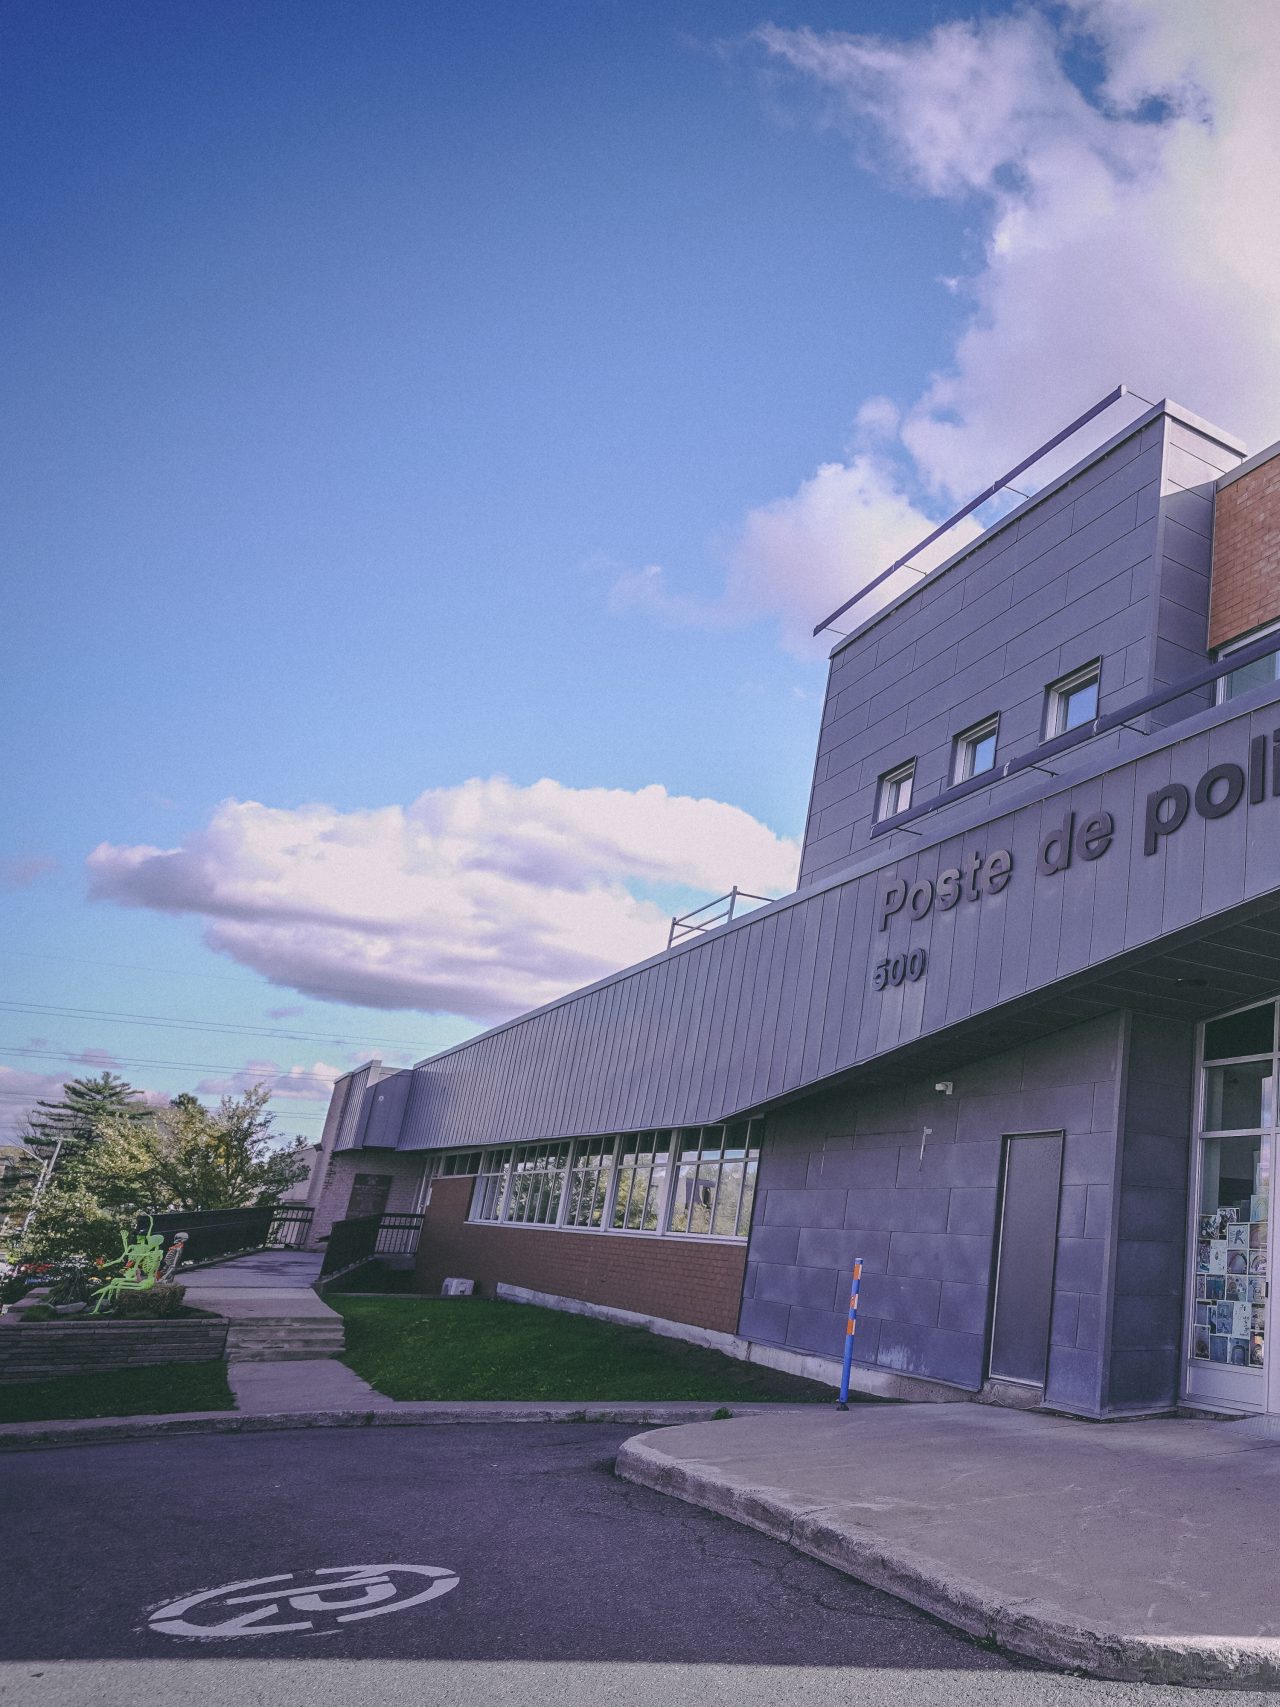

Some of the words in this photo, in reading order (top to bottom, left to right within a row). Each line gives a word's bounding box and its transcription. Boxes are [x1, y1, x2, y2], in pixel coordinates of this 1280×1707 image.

[878, 847, 1013, 932] Poste
[1035, 804, 1114, 877] de
[872, 946, 928, 992] 500
